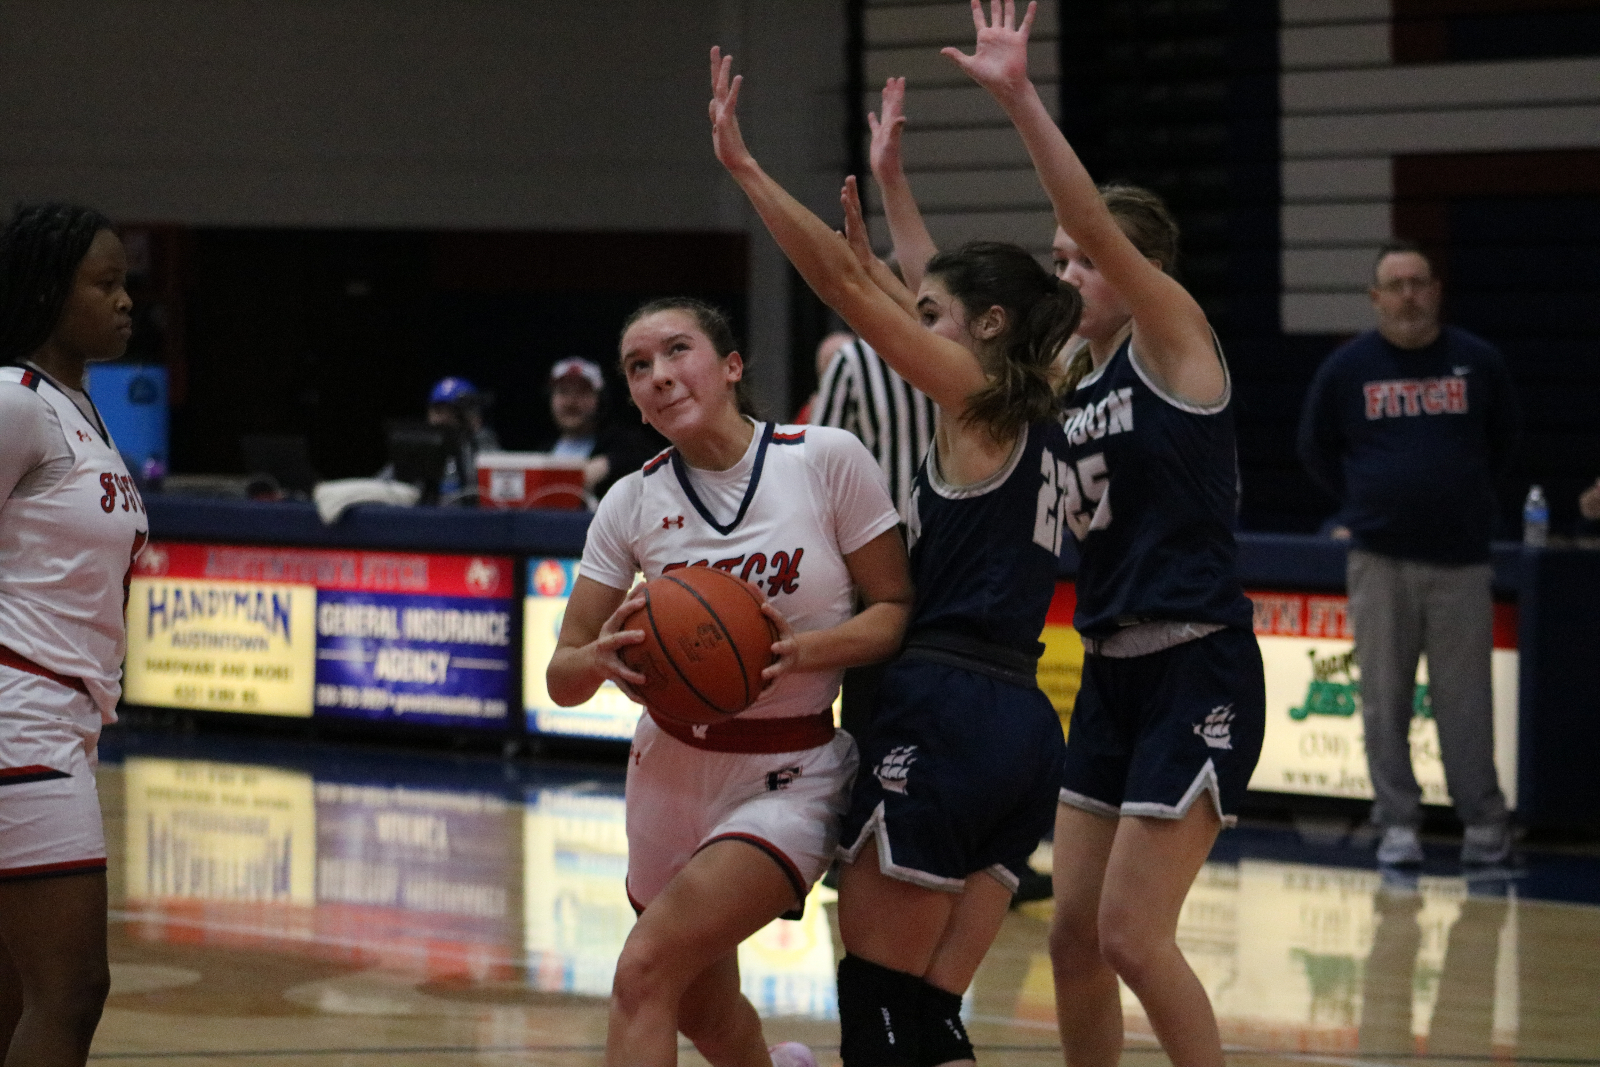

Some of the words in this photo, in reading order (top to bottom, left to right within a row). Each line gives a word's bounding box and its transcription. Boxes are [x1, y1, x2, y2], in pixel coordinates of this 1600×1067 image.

[1364, 376, 1469, 420] FITCH
[361, 555, 429, 589] FITCH
[147, 585, 292, 647] HANDYMAN
[318, 602, 400, 640] GENERAL
[402, 608, 511, 646] INSURANCE
[171, 629, 270, 653] AUSTINTOWN
[373, 648, 452, 685] AGENCY
